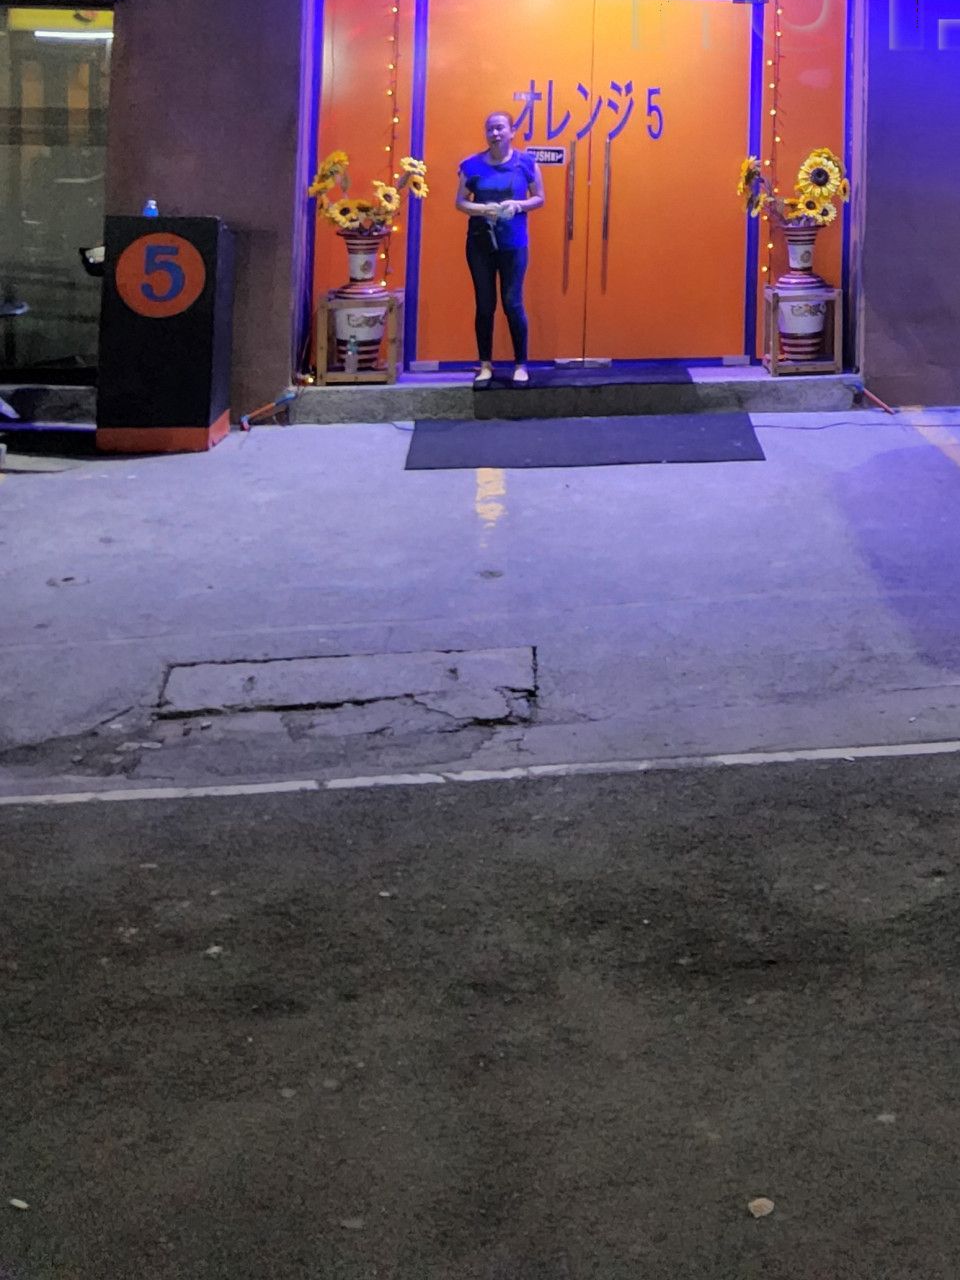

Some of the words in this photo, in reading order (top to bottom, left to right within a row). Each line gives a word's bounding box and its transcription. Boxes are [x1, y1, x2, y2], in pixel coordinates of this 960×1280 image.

[512, 79, 634, 141] オレンジ
[646, 87, 663, 140] 5
[528, 150, 551, 162] USH
[140, 244, 186, 303] 5
